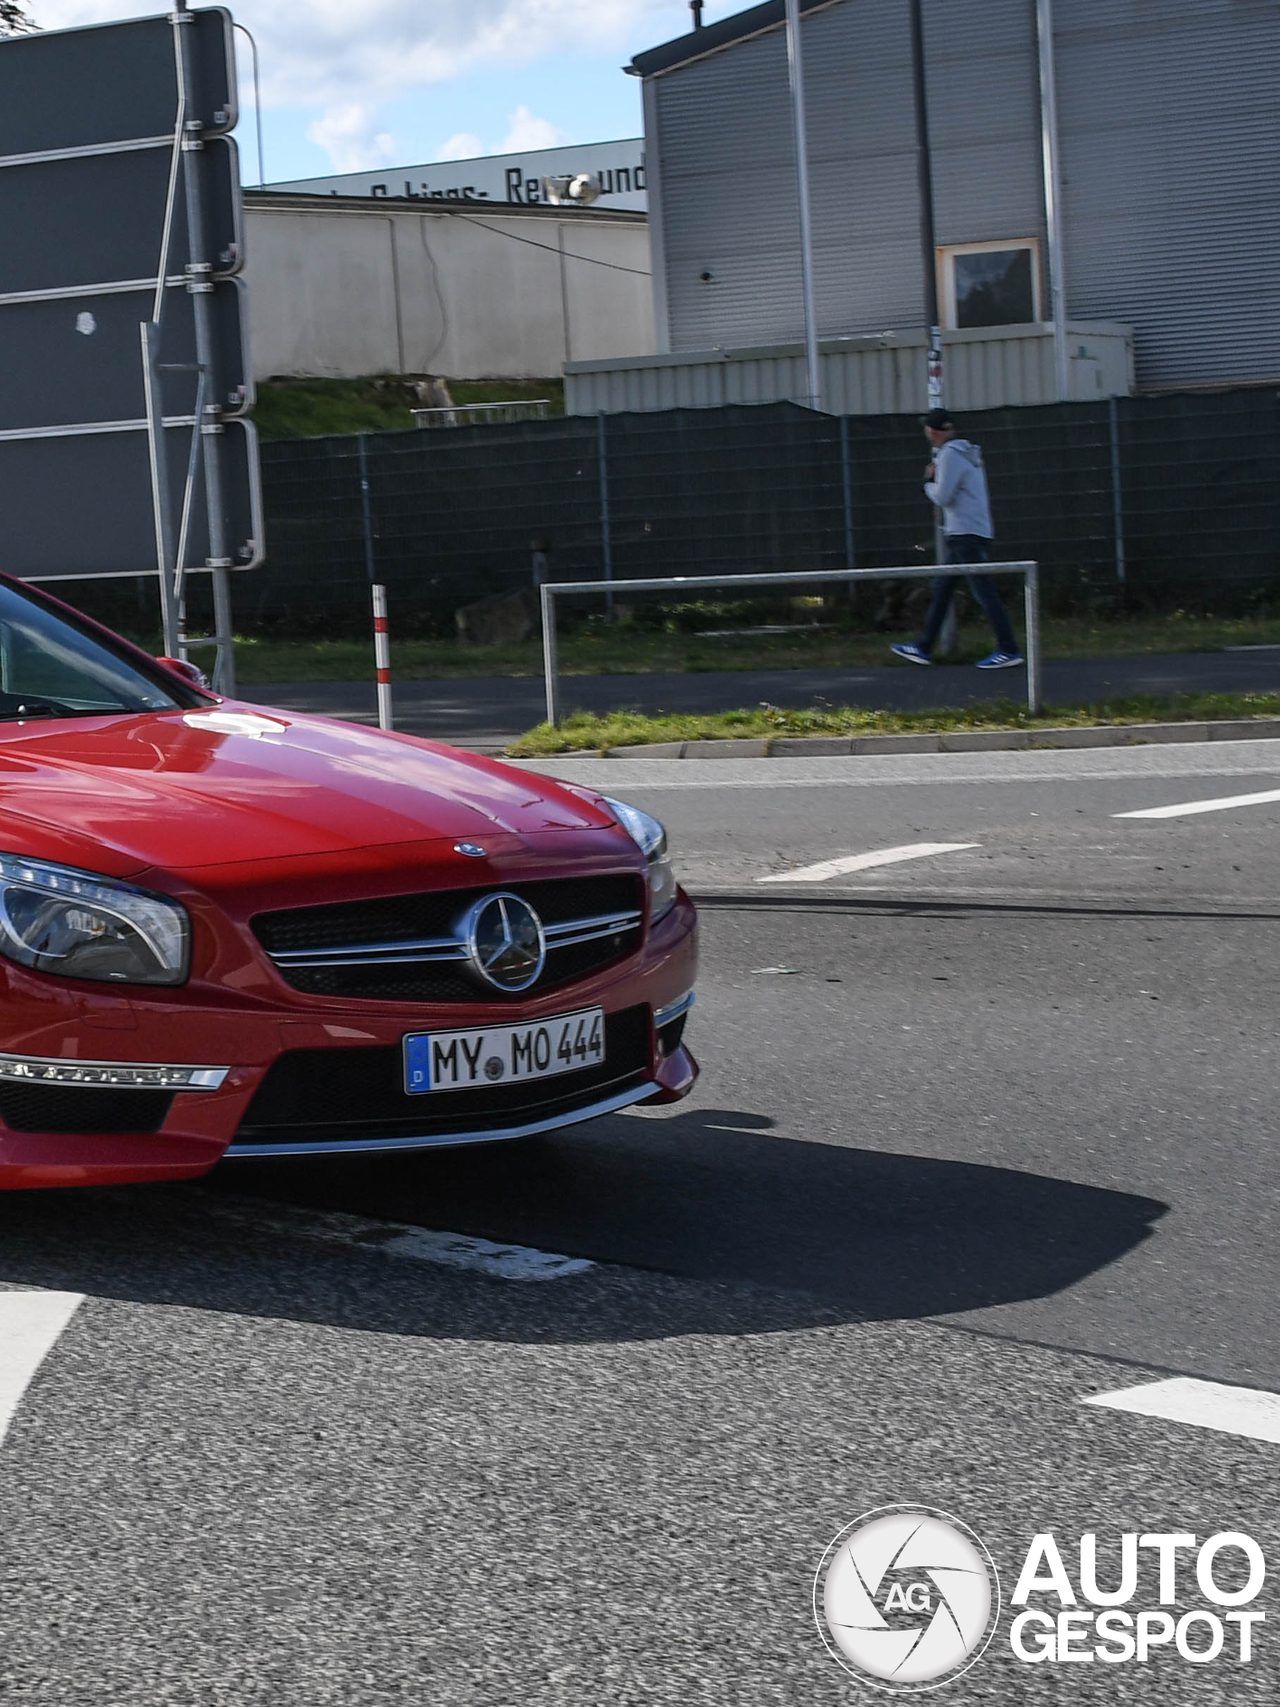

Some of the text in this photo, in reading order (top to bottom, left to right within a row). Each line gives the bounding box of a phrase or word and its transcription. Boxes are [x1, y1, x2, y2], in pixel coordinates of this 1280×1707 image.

[413, 1015, 602, 1084] D MY MO 444
